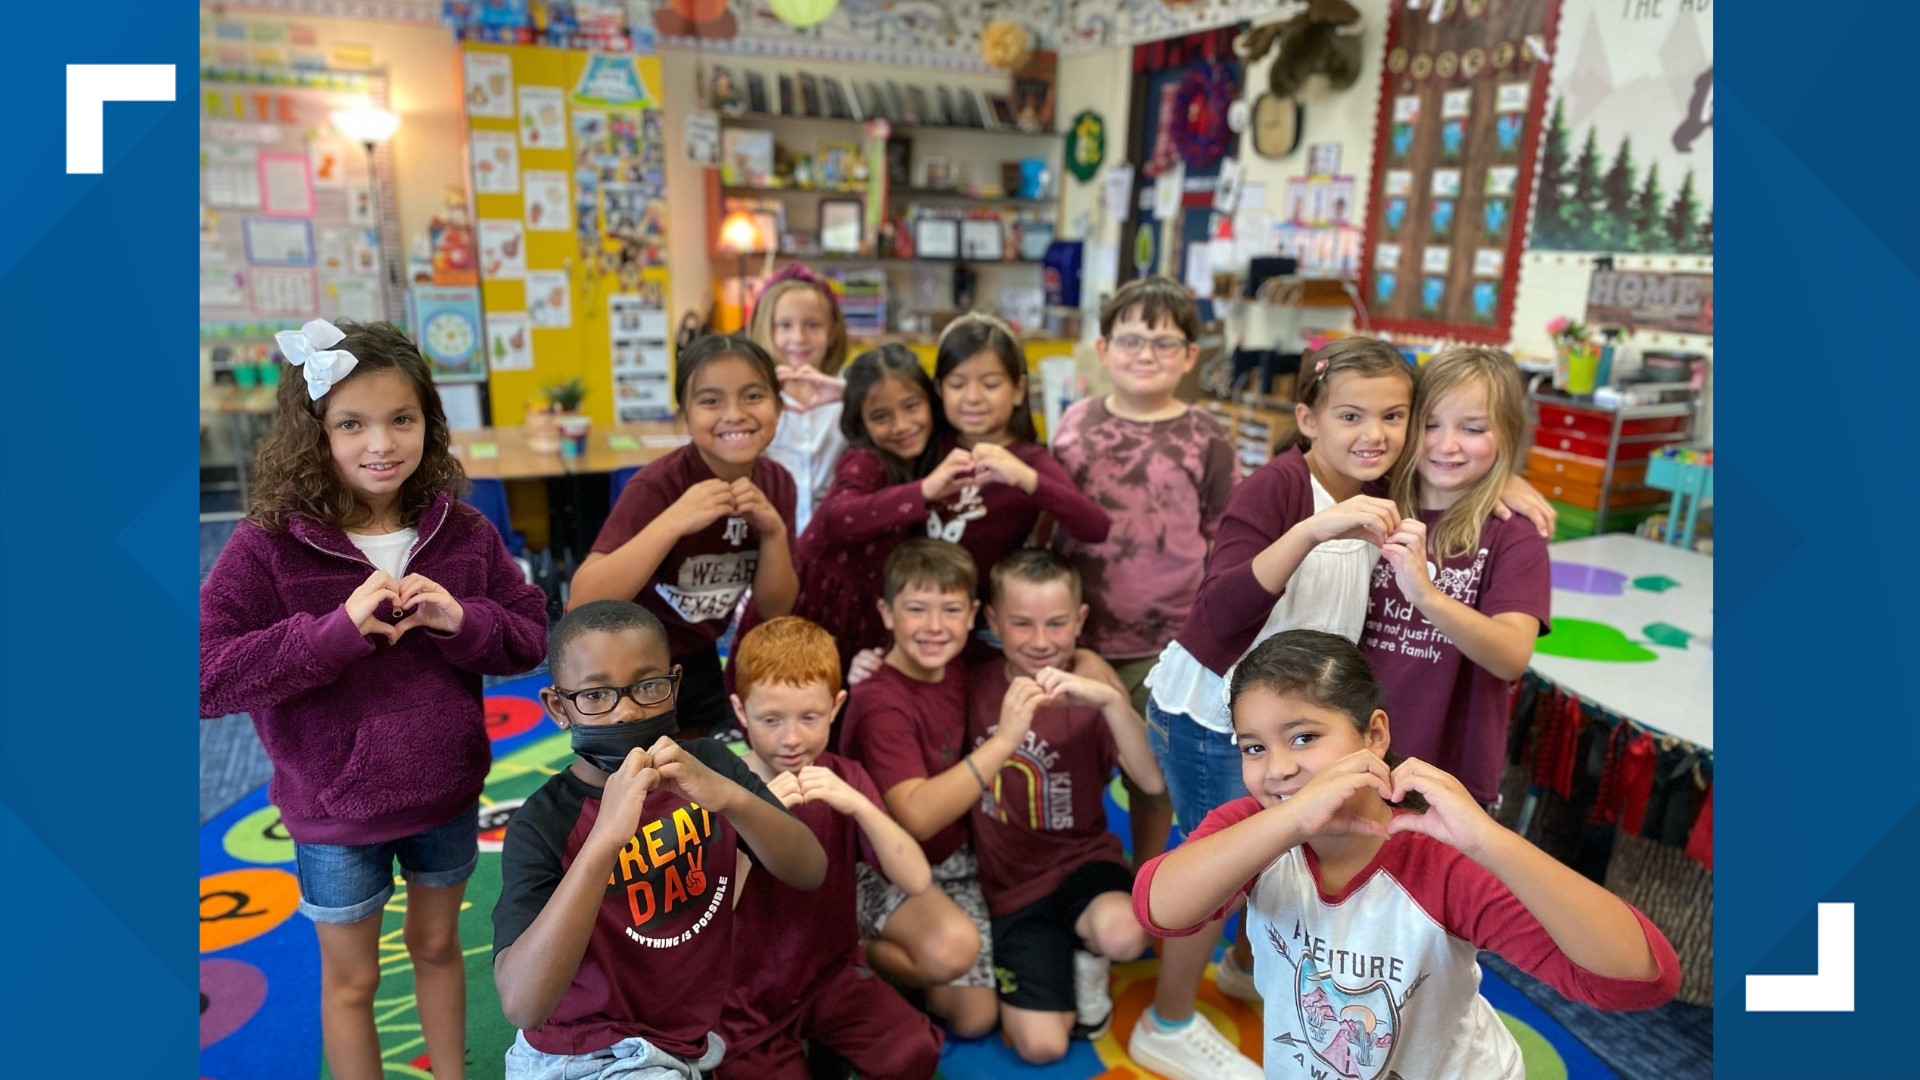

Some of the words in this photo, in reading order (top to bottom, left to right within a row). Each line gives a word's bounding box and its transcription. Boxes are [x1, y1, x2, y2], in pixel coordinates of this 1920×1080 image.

[1589, 271, 1701, 316] HOME
[692, 561, 724, 587] WE
[728, 559, 758, 584] AR
[1383, 597, 1414, 622] Kid
[1366, 620, 1382, 632] are
[1383, 624, 1400, 635] not
[1398, 626, 1428, 642] just
[1380, 640, 1396, 652] are
[1049, 771, 1075, 830] KINDS
[608, 802, 712, 885] REAT
[625, 926, 679, 949] ANYTHING
[681, 930, 693, 943] IS
[692, 875, 728, 934] POSSIBLE
[1293, 1052, 1344, 1080] AW
